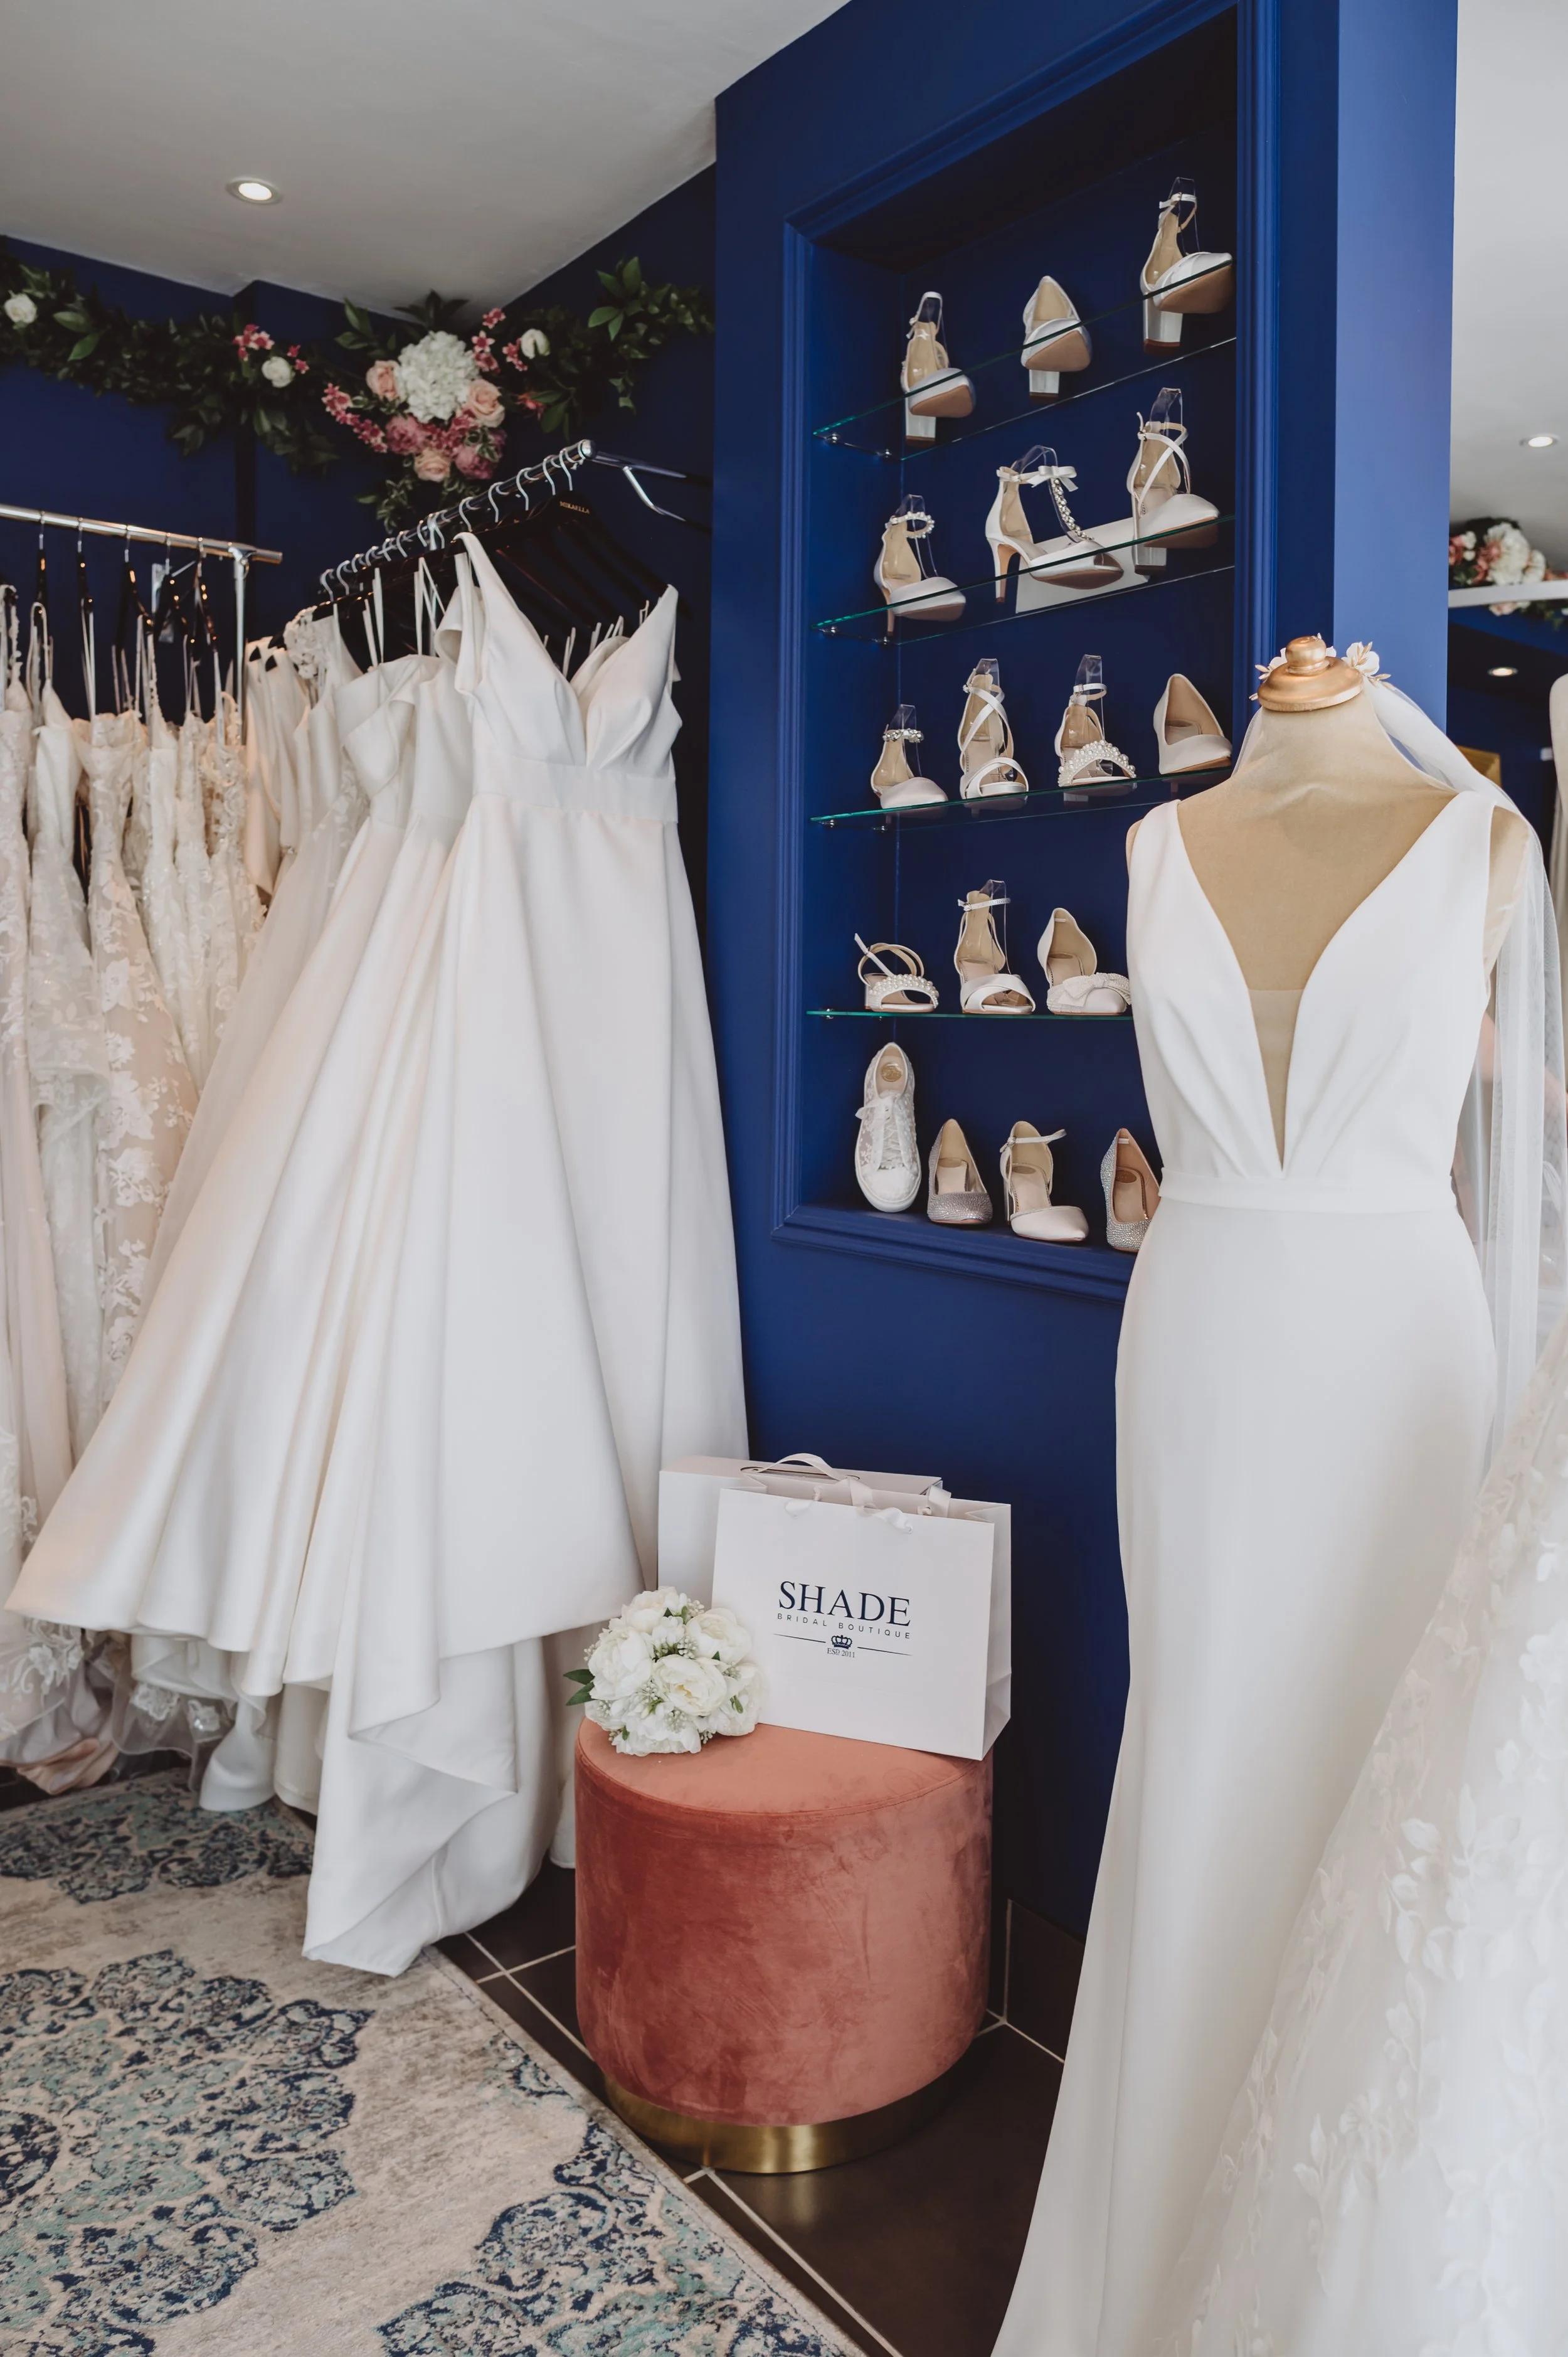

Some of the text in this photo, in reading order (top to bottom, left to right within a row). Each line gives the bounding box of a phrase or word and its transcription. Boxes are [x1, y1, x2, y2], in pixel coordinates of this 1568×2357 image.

[778, 1580, 911, 1626] SHADE
[777, 1613, 911, 1639] BRIDAL BOUTIQUE
[841, 1650, 855, 1658] 2011
